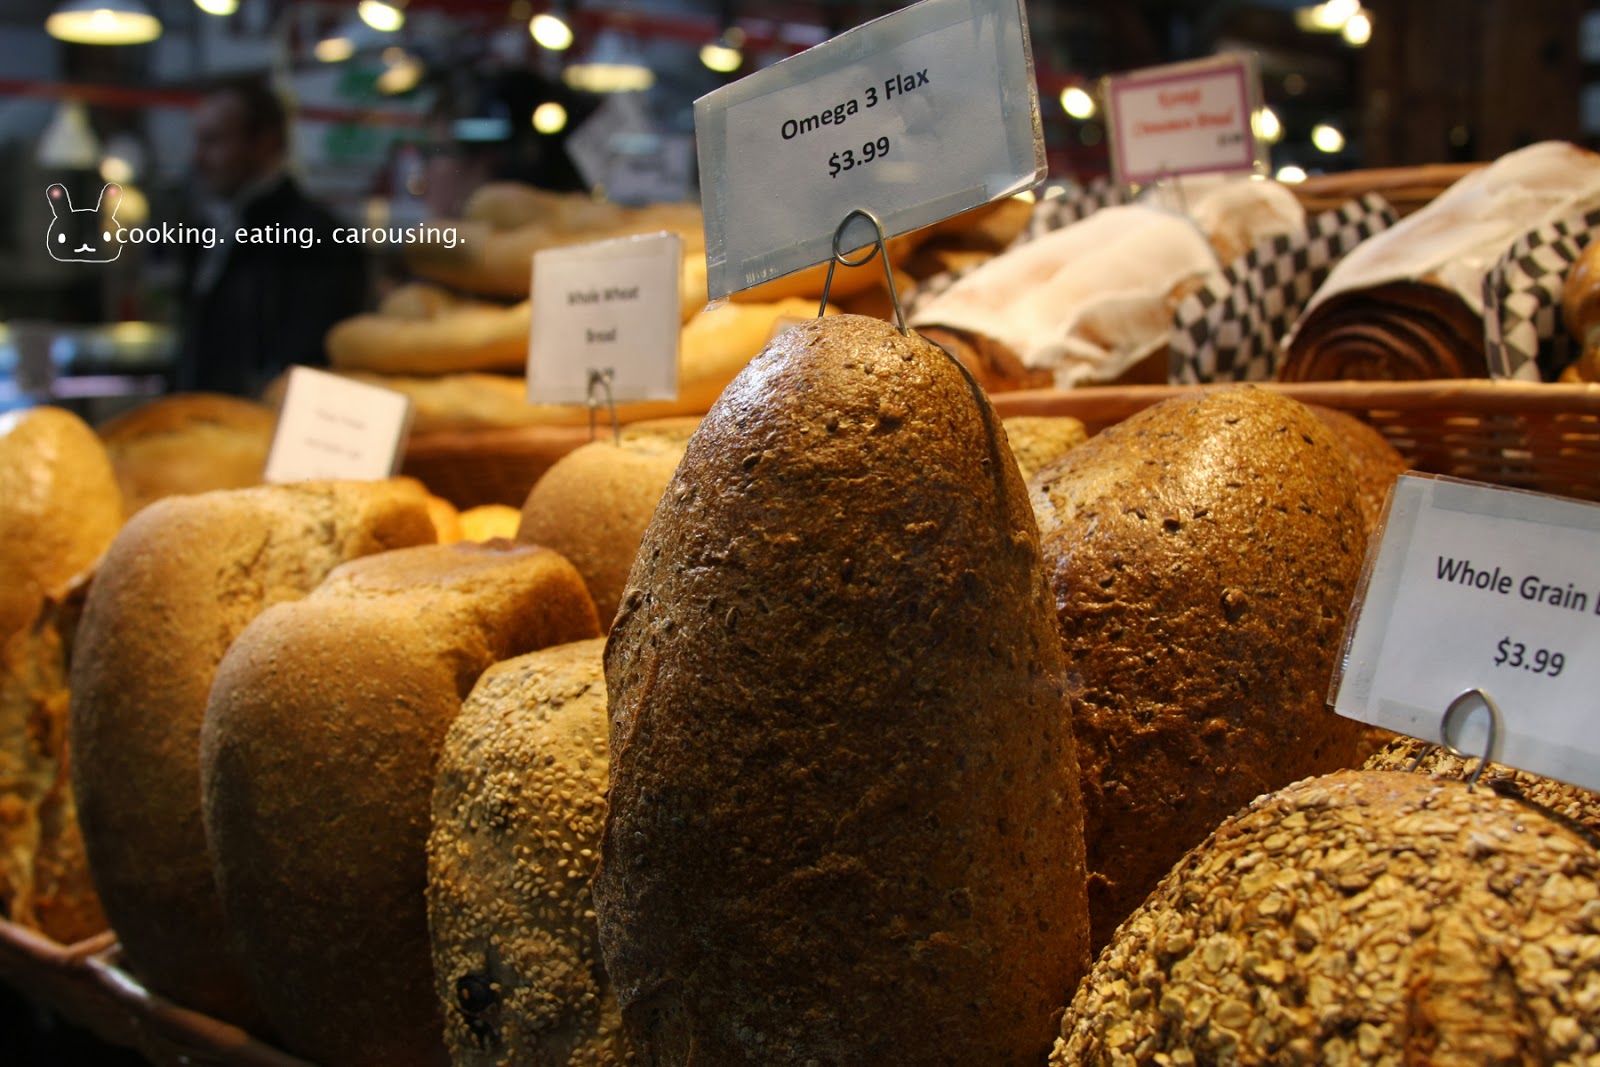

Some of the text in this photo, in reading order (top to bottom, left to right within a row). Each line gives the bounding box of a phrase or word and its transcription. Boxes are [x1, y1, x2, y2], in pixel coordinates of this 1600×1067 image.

[781, 68, 930, 140] Omega 3 Flax
[828, 136, 890, 178] $3.99
[1436, 556, 1512, 594] Whole
[1520, 576, 1587, 612] Grain
[1494, 636, 1565, 677] $3.99
